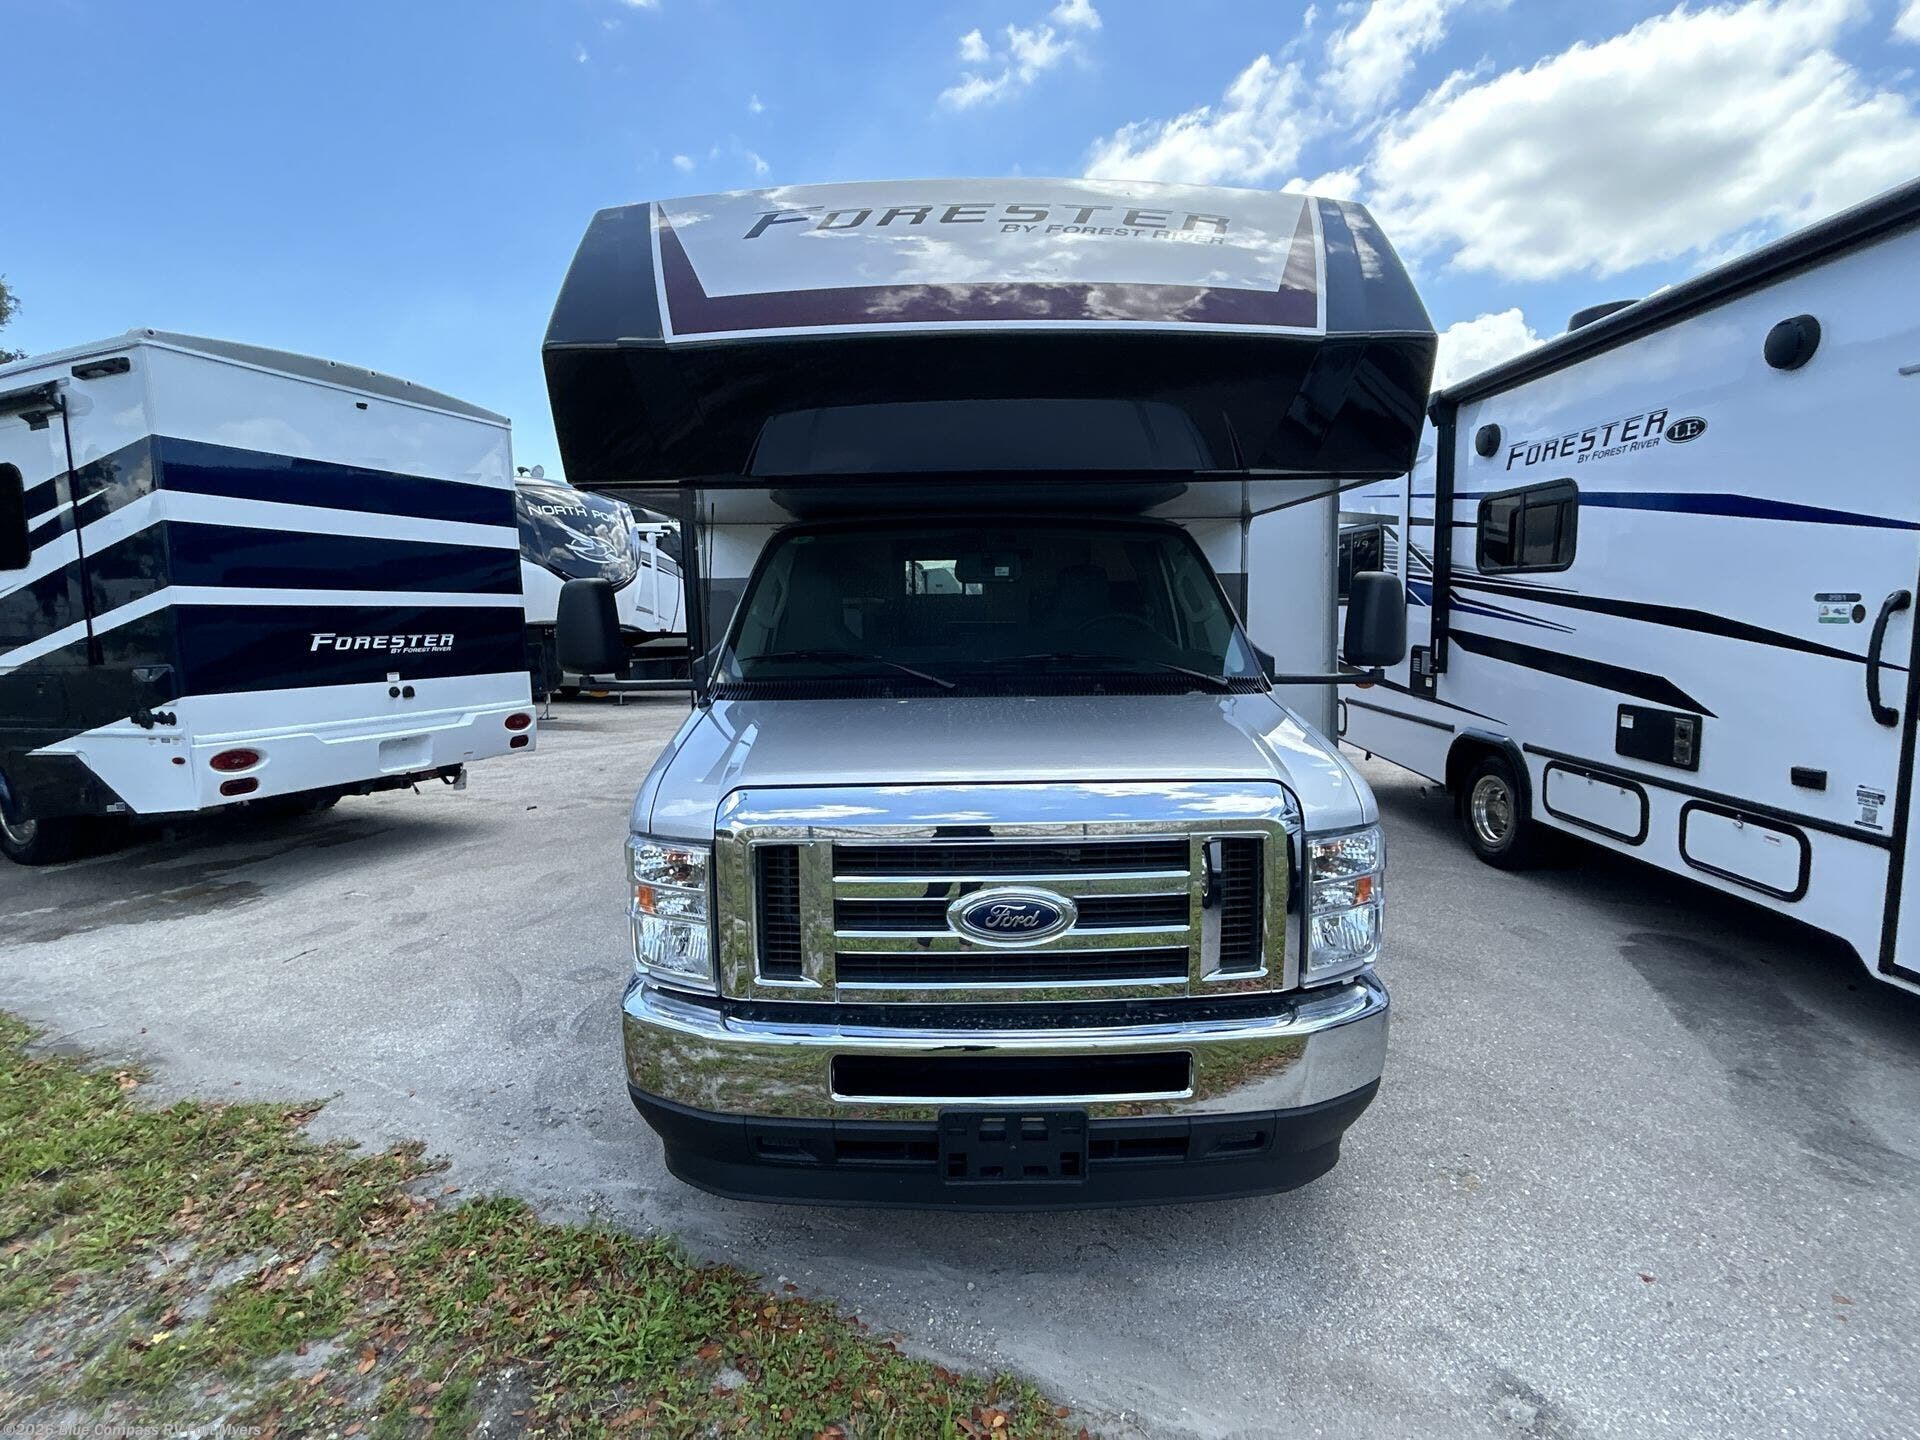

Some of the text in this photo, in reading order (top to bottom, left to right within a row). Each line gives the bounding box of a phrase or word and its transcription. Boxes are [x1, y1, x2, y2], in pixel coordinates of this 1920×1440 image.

[742, 202, 1233, 239] FORESTER
[1000, 223, 1225, 245] BY FOREST RIVER
[1506, 408, 1700, 471] FORESTER LE
[1577, 437, 1661, 464] BY FOREST RIVER
[527, 504, 588, 518] NORTH
[310, 633, 455, 652] FORESTER
[402, 646, 431, 654] FOREST
[985, 904, 1041, 928] Ford
